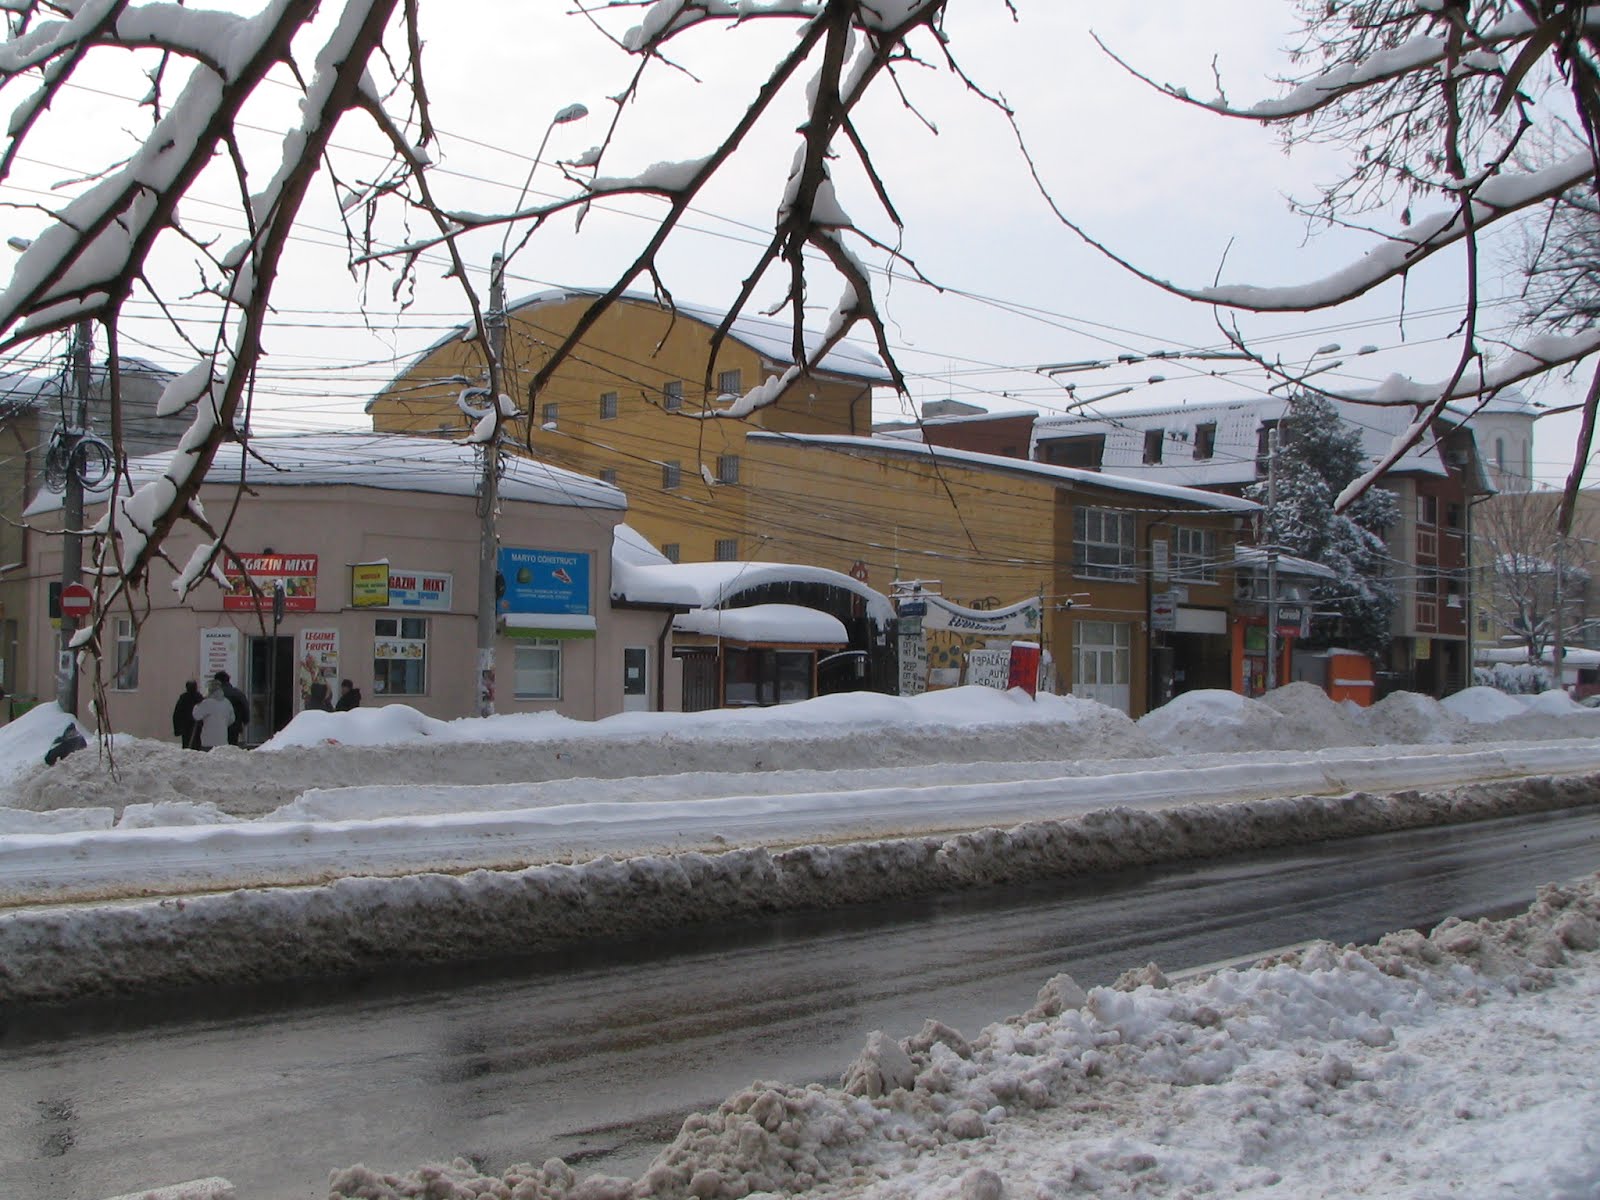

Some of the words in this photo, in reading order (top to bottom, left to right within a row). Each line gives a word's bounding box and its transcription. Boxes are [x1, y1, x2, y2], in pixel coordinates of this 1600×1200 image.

[227, 558, 282, 571] MGAZIN
[285, 559, 315, 571] MIXT
[512, 553, 536, 562] MARYO
[537, 555, 577, 566] CONSTRUCT
[423, 578, 446, 592] MIXT
[305, 631, 336, 641] LEGUME
[305, 642, 335, 651] FRUCTE
